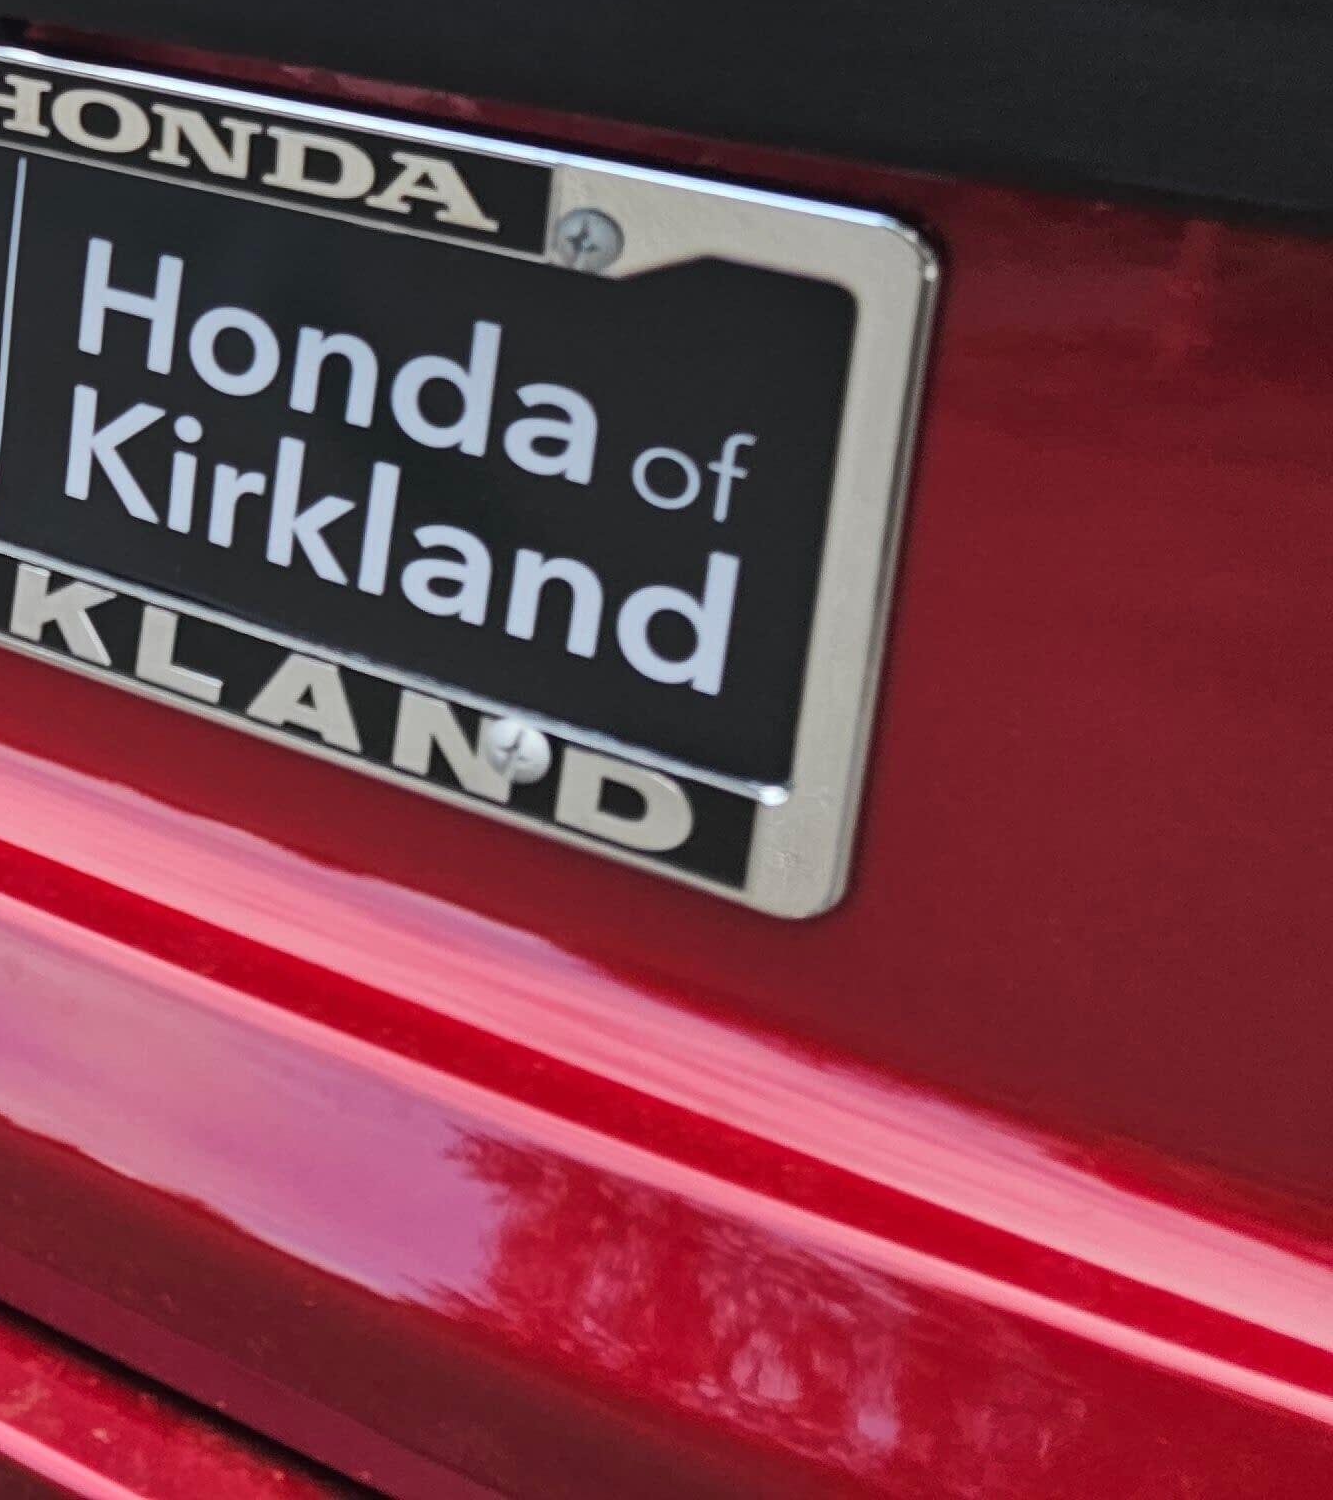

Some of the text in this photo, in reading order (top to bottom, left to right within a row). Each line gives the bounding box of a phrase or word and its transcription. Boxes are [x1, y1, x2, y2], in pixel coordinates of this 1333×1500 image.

[77, 238, 757, 523] Honda of
[64, 385, 740, 696] Kirkland
